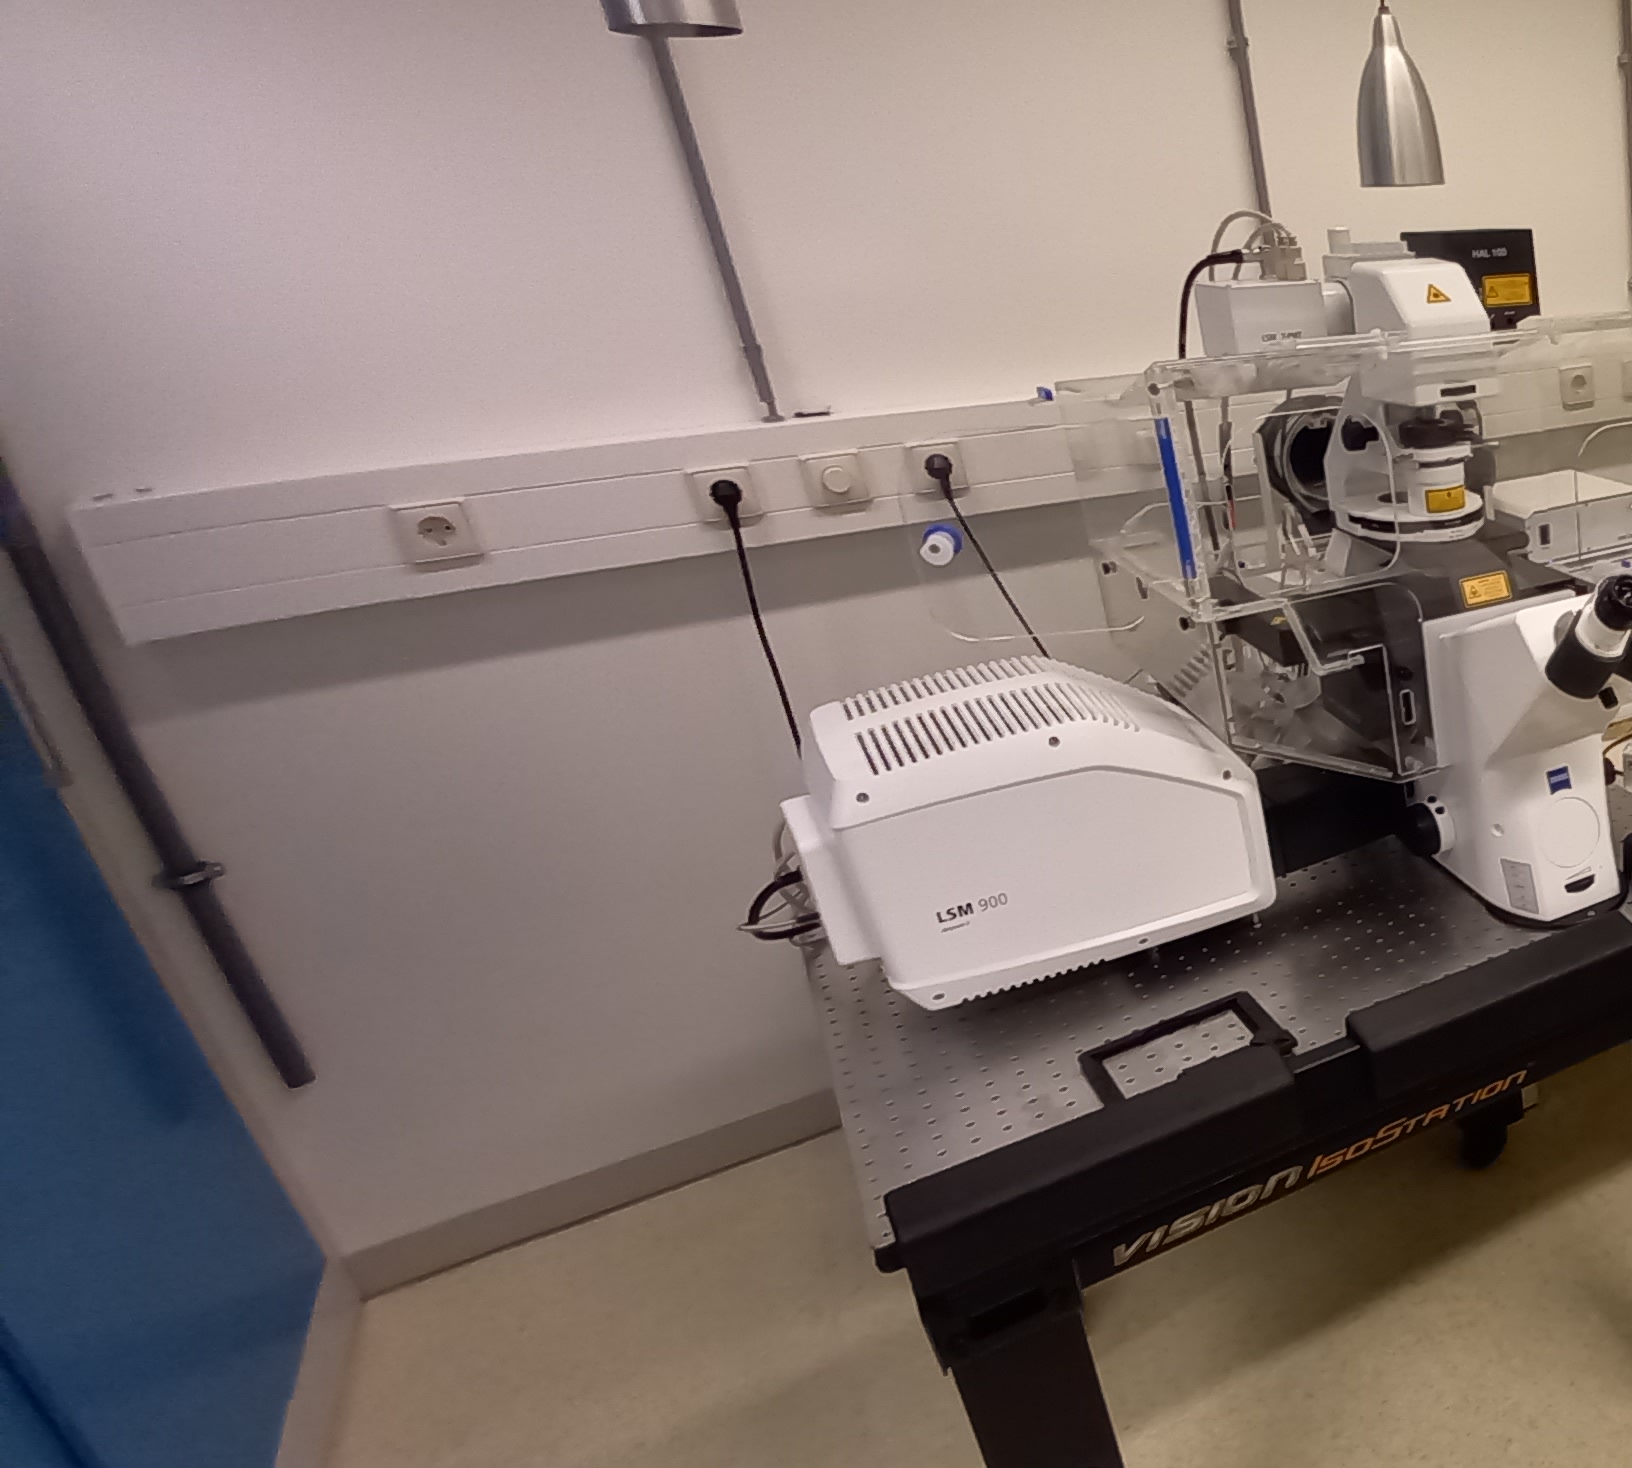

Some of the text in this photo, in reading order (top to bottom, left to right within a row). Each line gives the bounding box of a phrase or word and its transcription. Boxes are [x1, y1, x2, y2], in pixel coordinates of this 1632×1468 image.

[1471, 248, 1491, 259] HAL
[936, 892, 1008, 924] LSM 900
[1112, 1165, 1303, 1267] VISION
